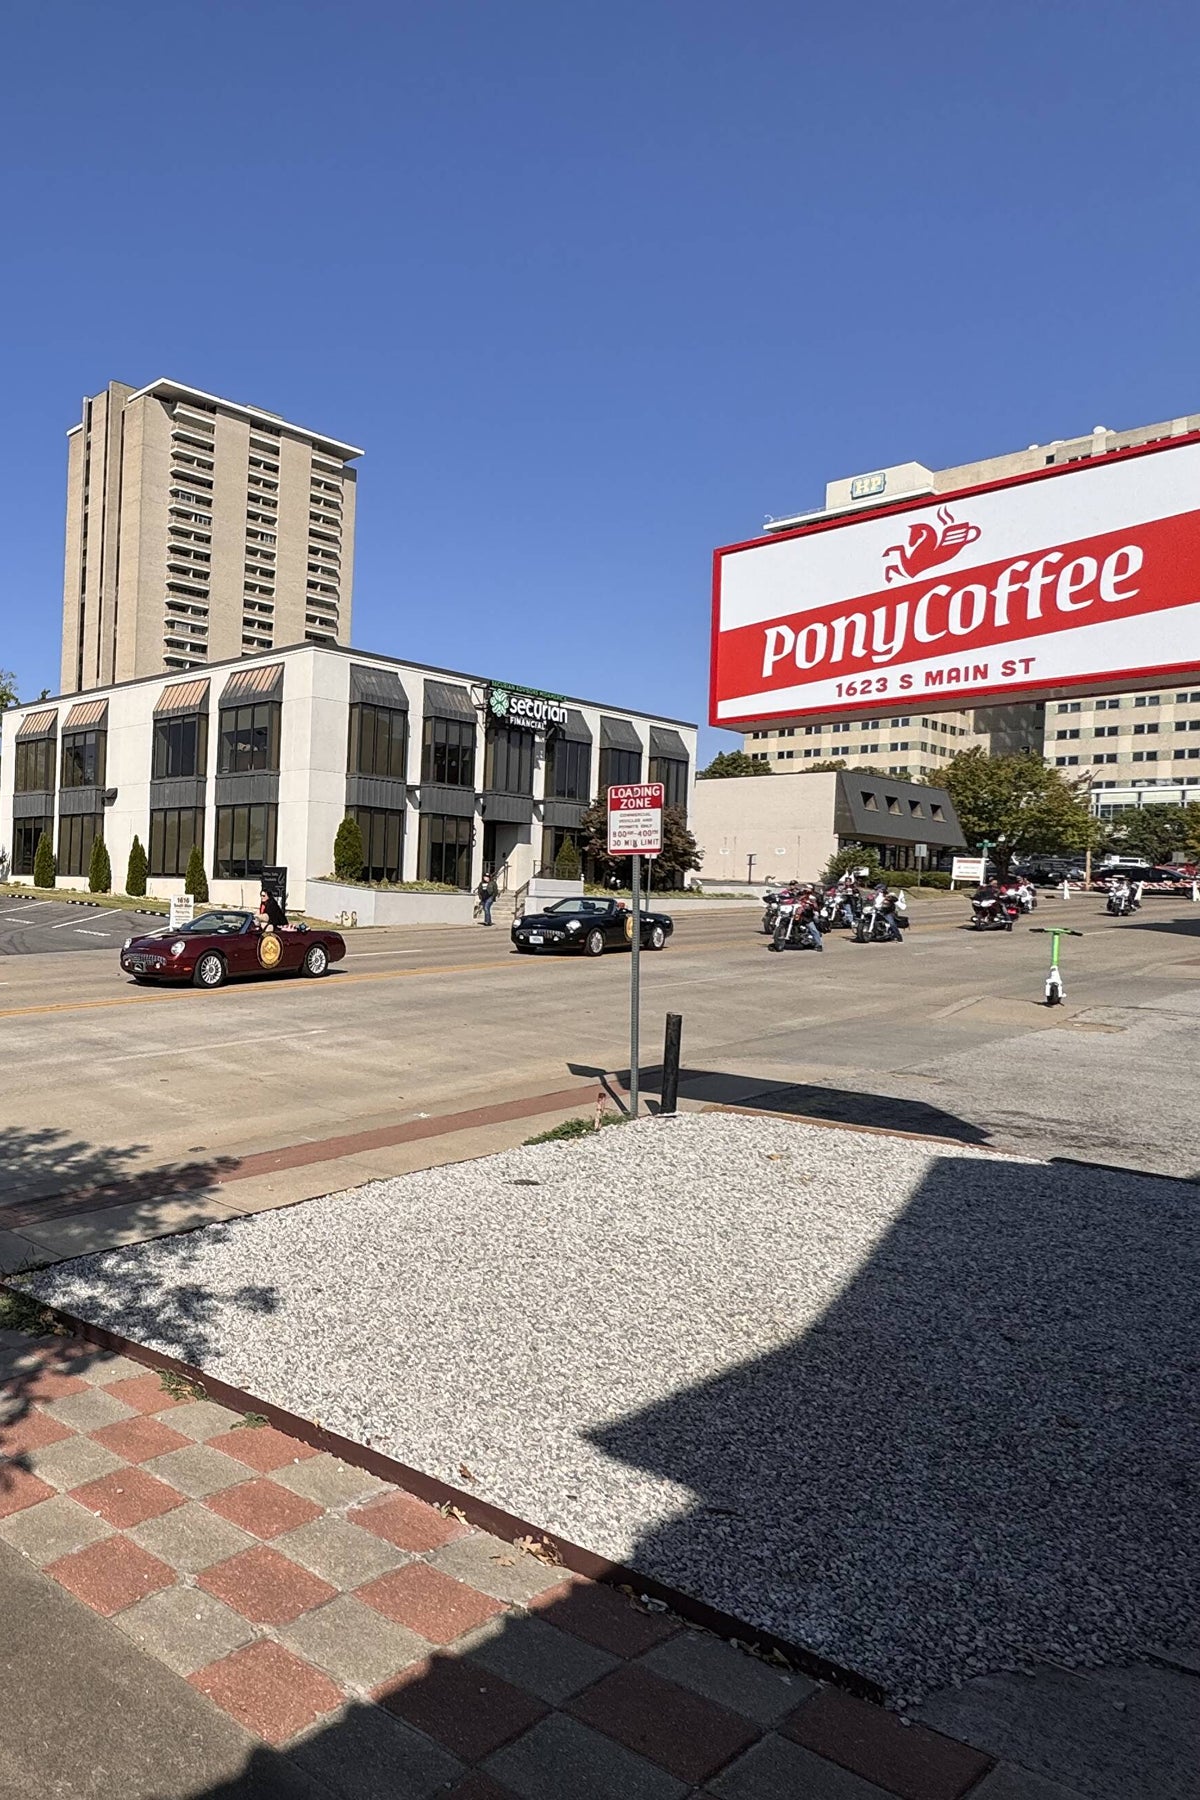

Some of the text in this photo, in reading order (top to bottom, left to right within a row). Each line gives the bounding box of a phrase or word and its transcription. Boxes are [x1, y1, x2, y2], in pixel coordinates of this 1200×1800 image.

[835, 657, 1036, 698] 1623 S MAIN ST
[509, 716, 547, 730] FINANCIAL
[611, 786, 660, 799] LOADING
[620, 797, 652, 809] ZONE
[640, 838, 660, 846] LIMIT
